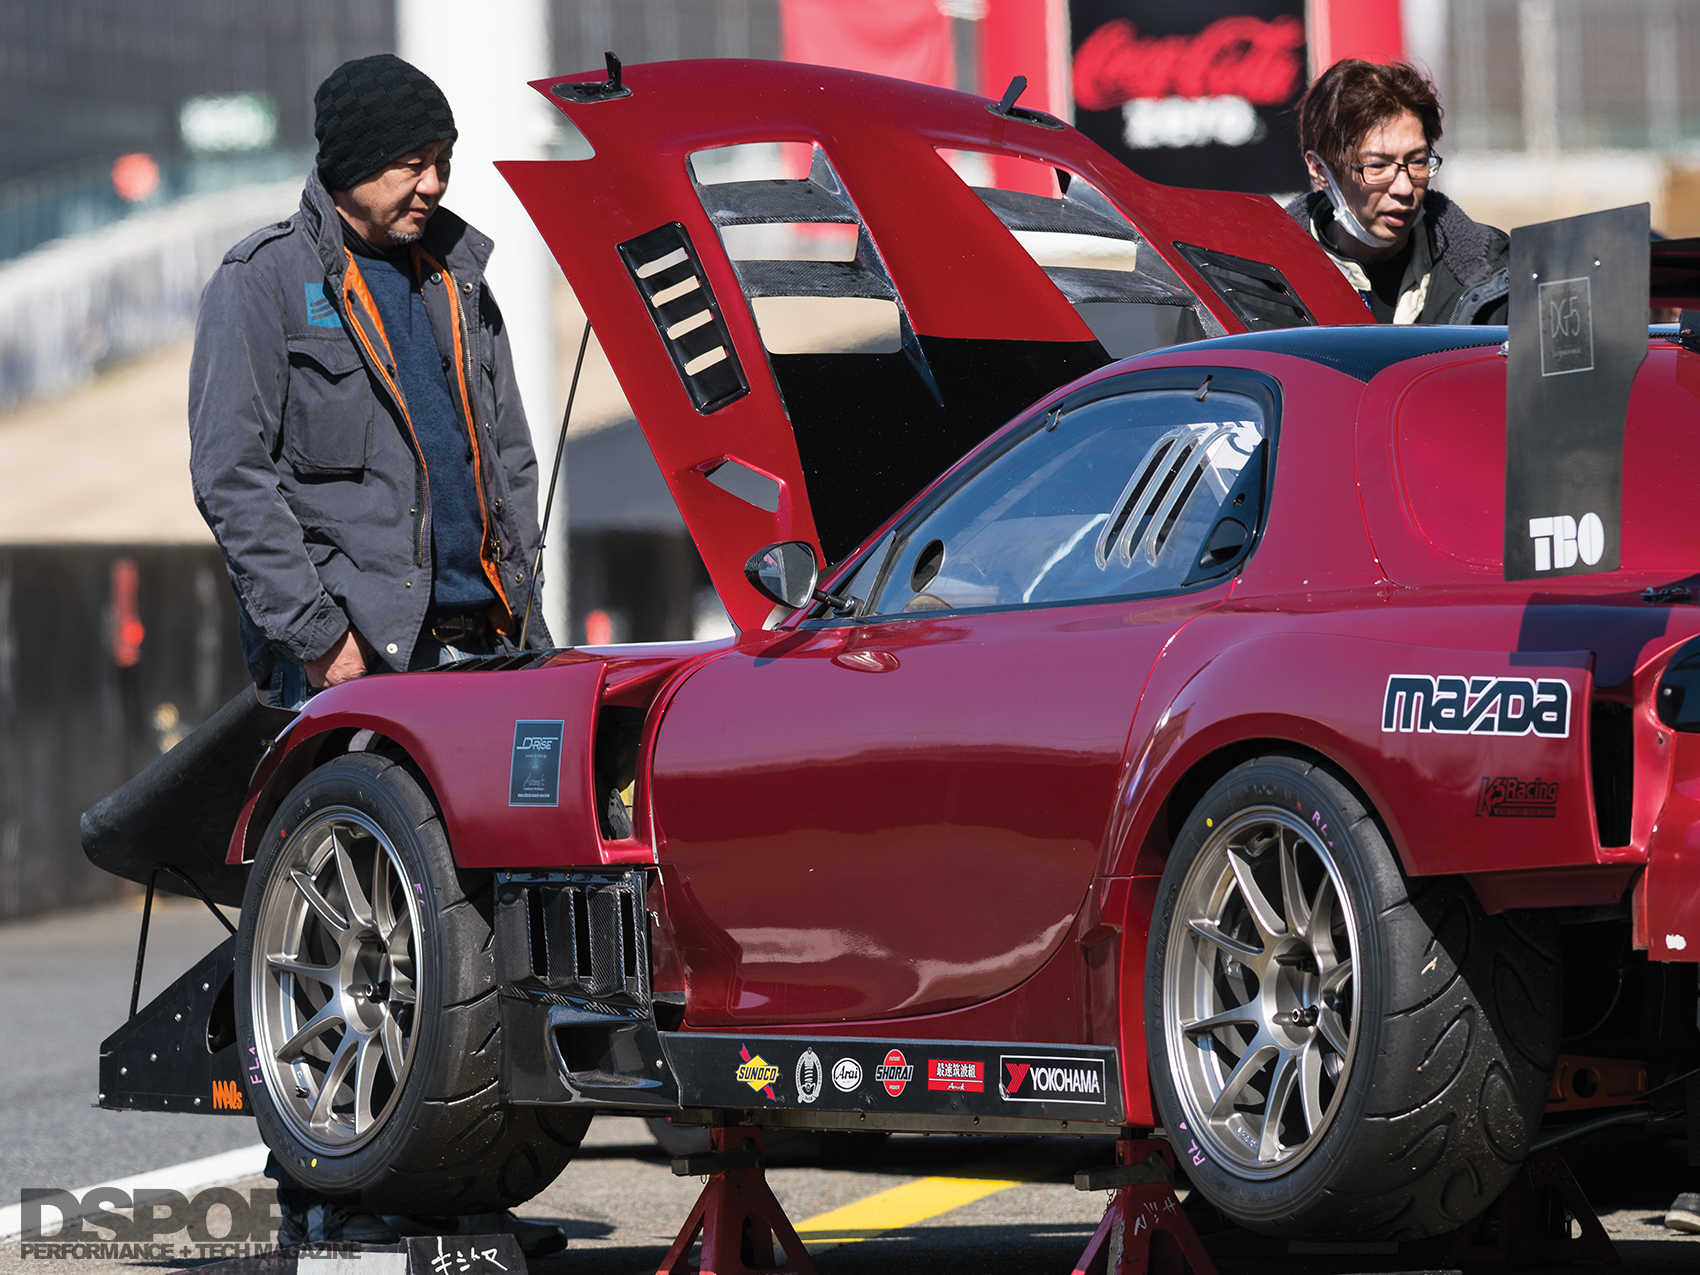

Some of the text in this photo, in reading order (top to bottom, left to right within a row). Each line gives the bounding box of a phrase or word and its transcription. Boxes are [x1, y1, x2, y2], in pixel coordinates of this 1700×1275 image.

[1529, 512, 1605, 571] TBO
[738, 1066, 777, 1081] SUNOCO
[835, 1065, 859, 1080] Arai
[876, 1066, 913, 1081] SHORAI
[1029, 1067, 1100, 1093] YOKOHAMA
